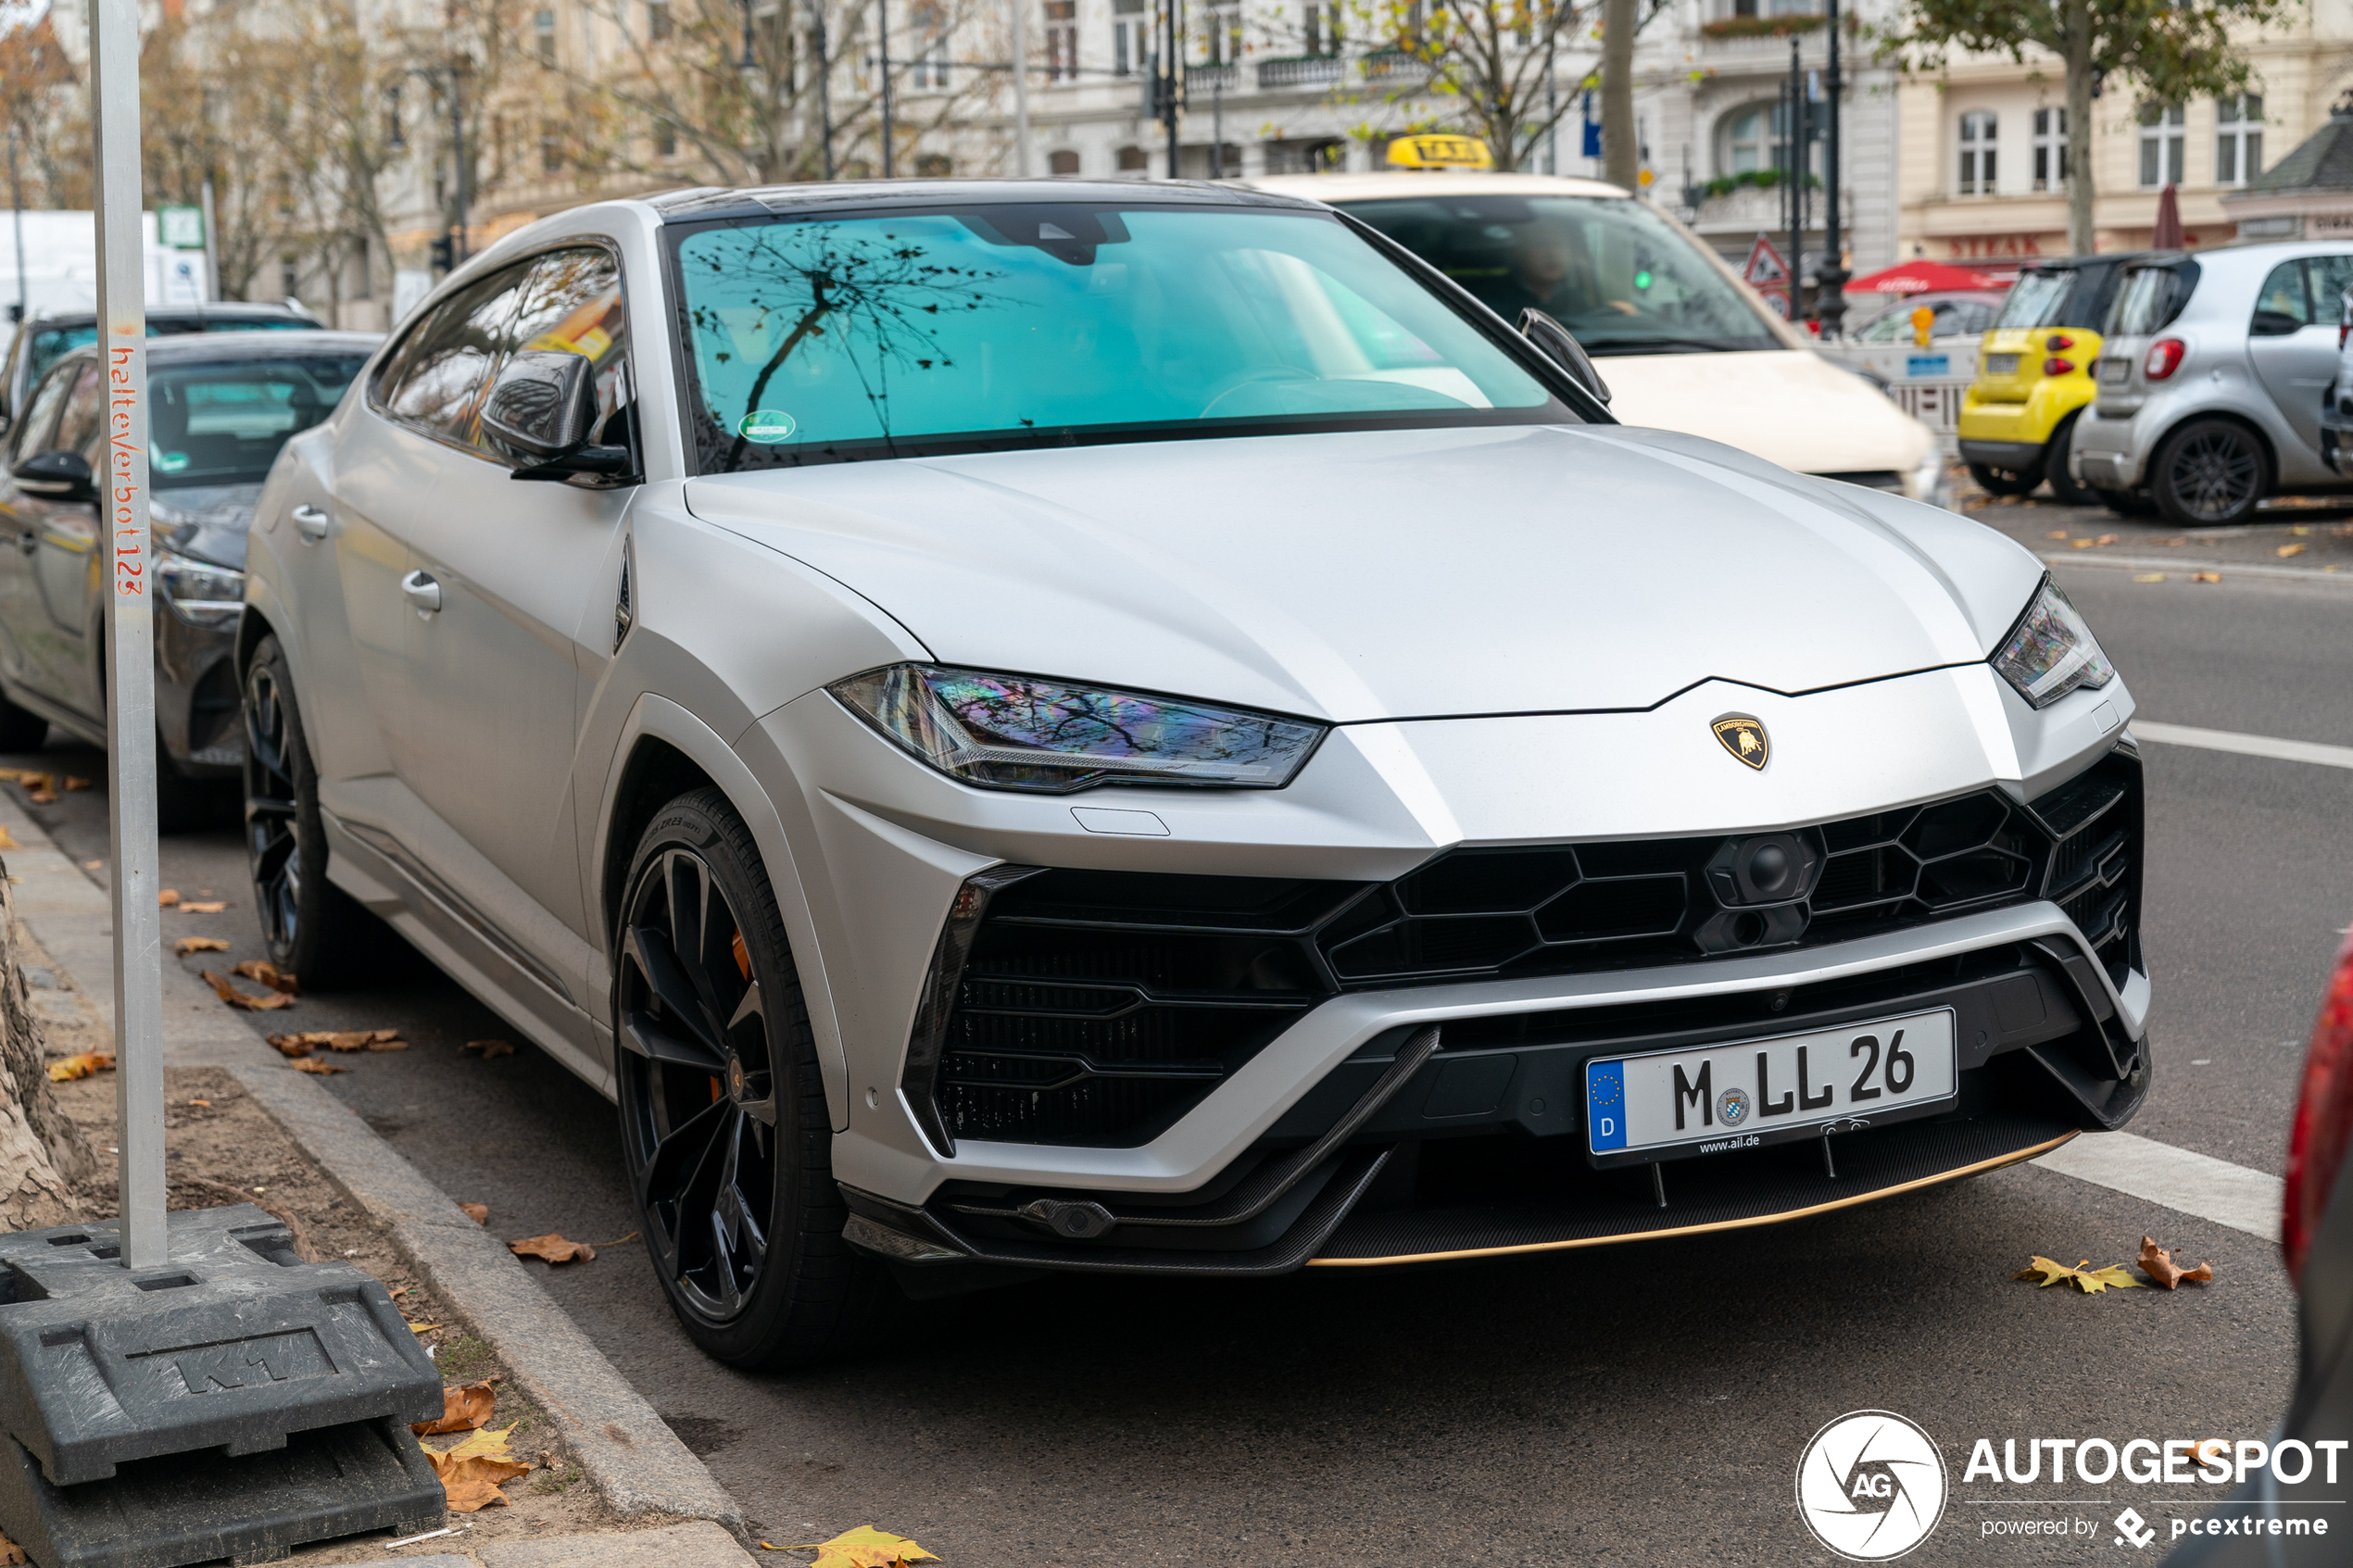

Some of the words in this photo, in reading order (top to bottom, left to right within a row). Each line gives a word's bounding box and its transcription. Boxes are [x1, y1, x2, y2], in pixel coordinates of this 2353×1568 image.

[1948, 235, 2040, 257] STEAK
[1717, 721, 1758, 733] LAMBORGHINI
[1673, 1060, 1712, 1130] M
[1756, 1046, 1833, 1117] LL
[1850, 1028, 1915, 1102] 26
[1601, 1117, 1615, 1137] D
[1699, 1135, 1760, 1154] www.ail.de
